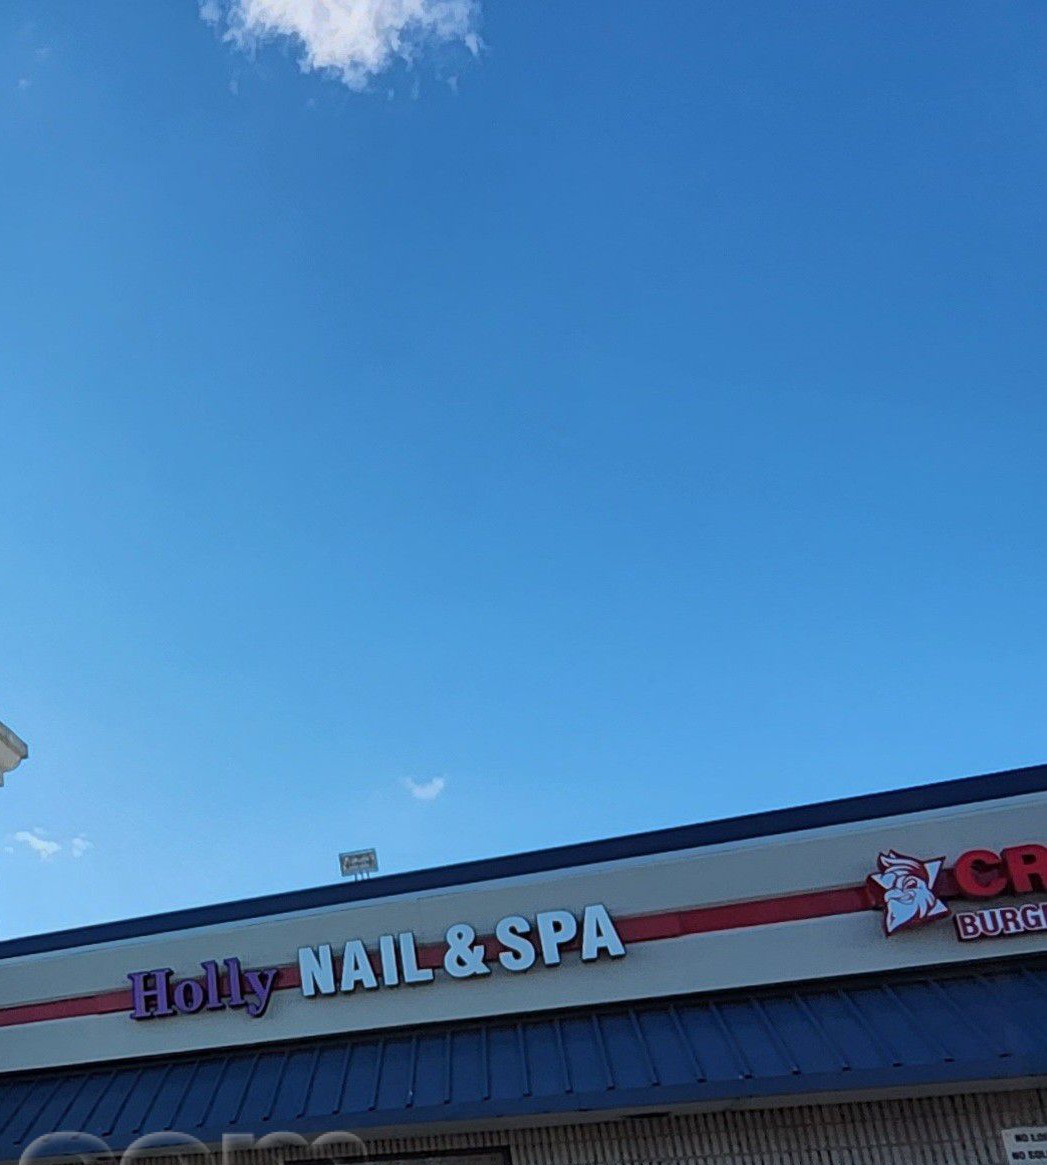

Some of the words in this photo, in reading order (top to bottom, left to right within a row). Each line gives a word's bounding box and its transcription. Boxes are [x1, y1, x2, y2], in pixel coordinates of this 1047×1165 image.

[956, 901, 1047, 941] BURG
[128, 956, 281, 1020] Holly
[298, 931, 434, 997] NAIL
[443, 923, 491, 979] &
[495, 903, 627, 971] SPA
